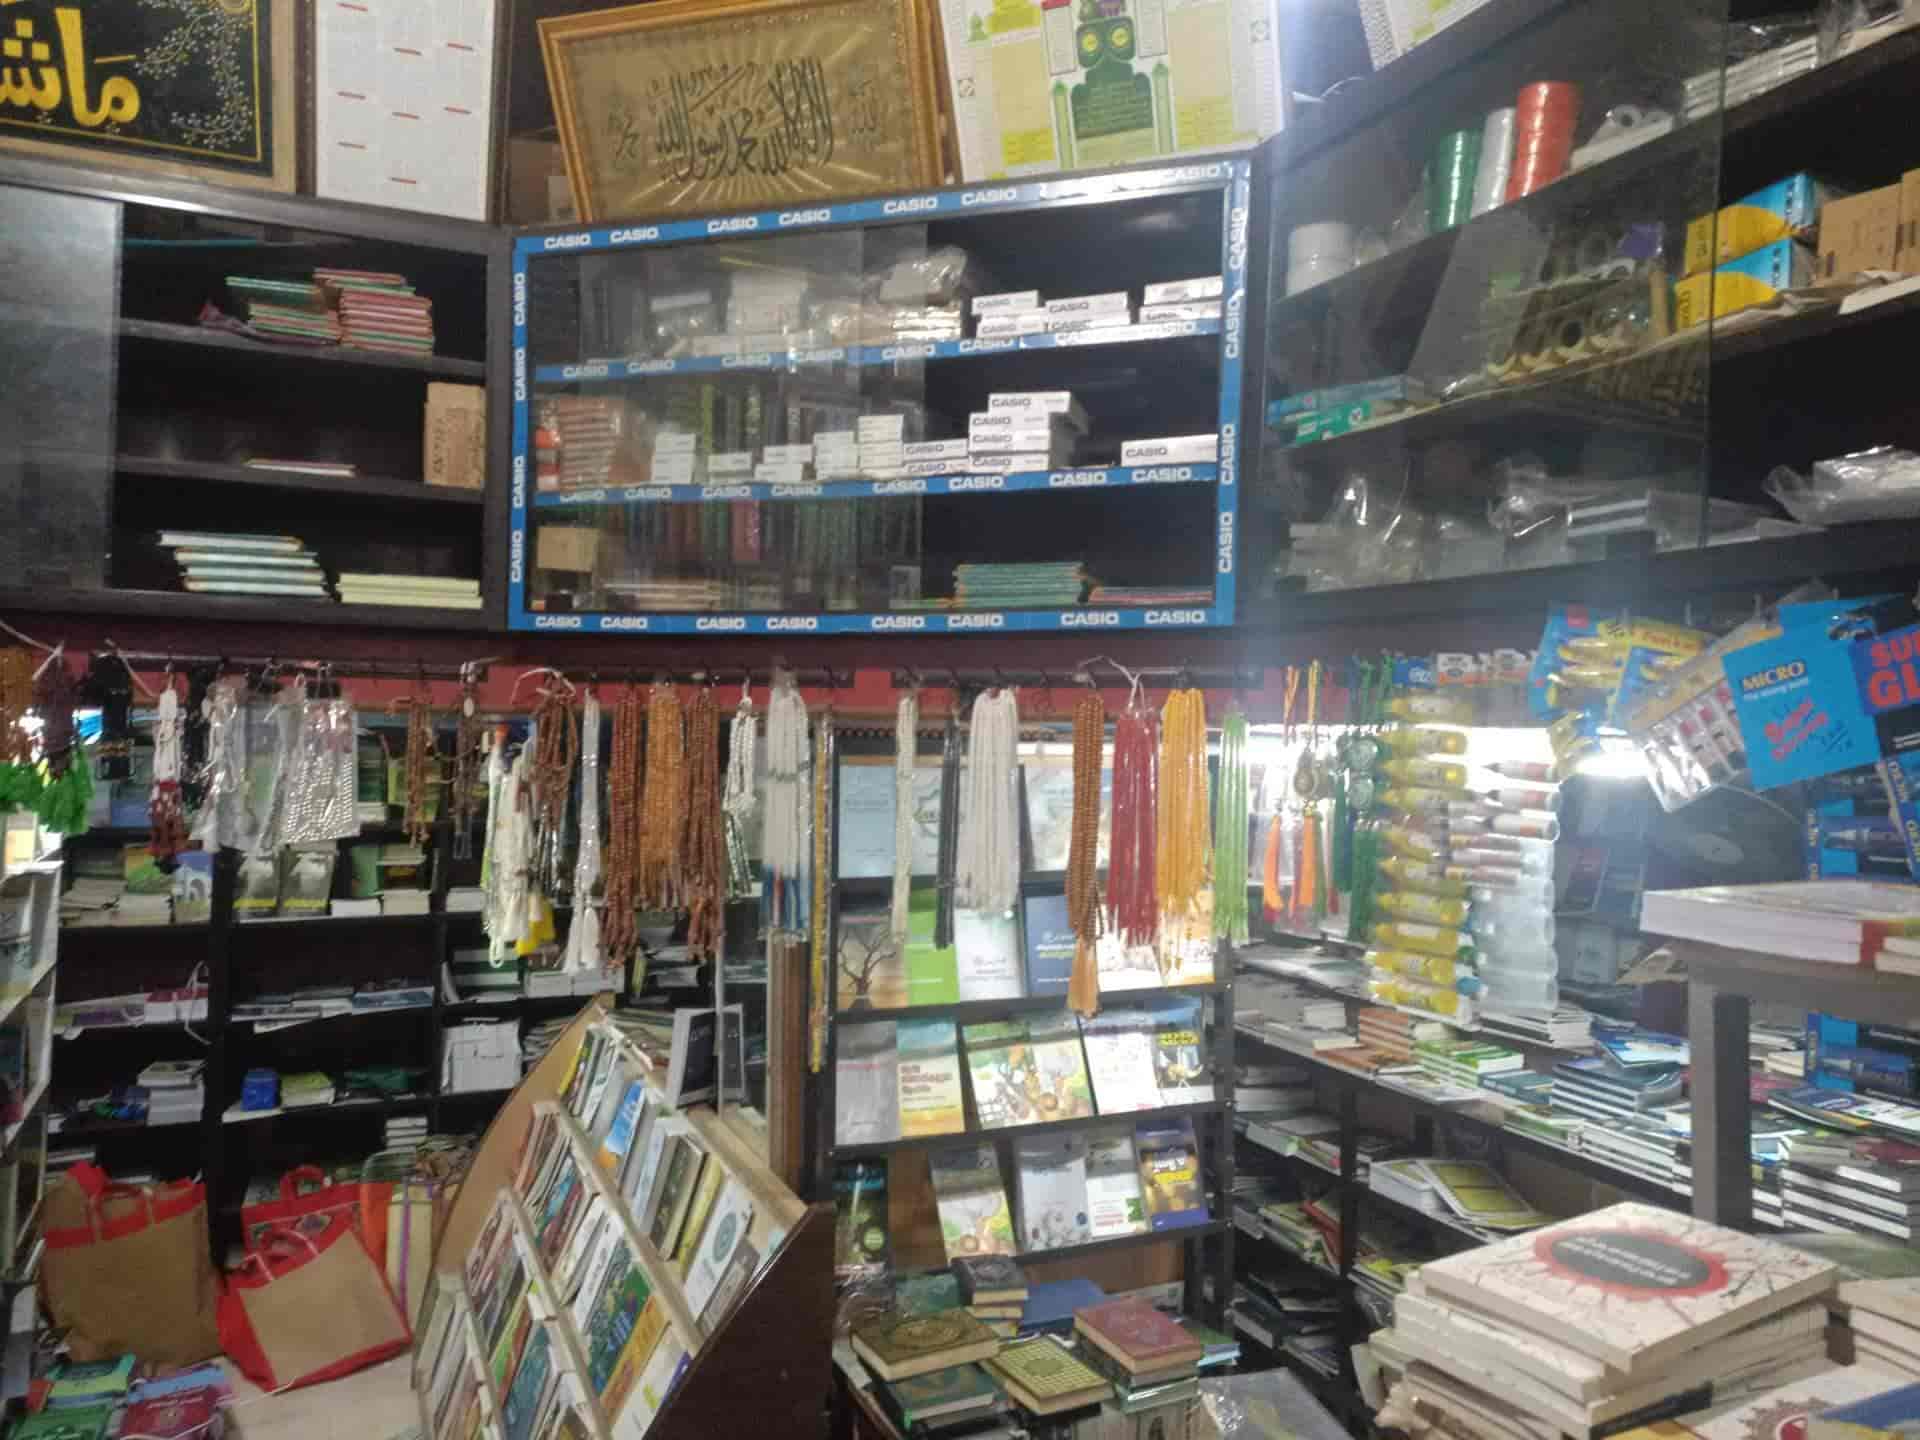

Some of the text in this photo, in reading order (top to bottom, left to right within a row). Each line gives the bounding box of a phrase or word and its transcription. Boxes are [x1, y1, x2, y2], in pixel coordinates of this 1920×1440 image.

[884, 196, 937, 214] CASIO
[961, 188, 1017, 207] CASIO
[707, 215, 758, 234] CASIO
[779, 208, 831, 226] CASIO
[544, 232, 592, 249] CASIO
[610, 226, 659, 243] CASIO
[1229, 207, 1247, 268] CASIO
[513, 272, 526, 326] CASIO
[1050, 301, 1089, 314] CASIO
[1225, 299, 1239, 359] CASIO
[882, 344, 936, 359] CASIO
[959, 337, 1014, 352] CASIO
[563, 364, 608, 379] CASIO
[627, 358, 675, 374] CASIO
[512, 350, 527, 401] CASIO
[991, 397, 1031, 408] CASIO
[972, 416, 1012, 427] CASIO
[972, 432, 1013, 443] CASIO
[906, 443, 945, 455] CASIO
[1125, 446, 1168, 458] CASIO
[1220, 423, 1235, 485] CASIO
[907, 462, 946, 473] CASIO
[972, 456, 1012, 467] CASIO
[513, 456, 524, 509] CASIO
[1049, 470, 1107, 487] CASIO
[1131, 466, 1192, 484] CASIO
[771, 484, 822, 497] CASIO
[872, 479, 927, 494] CASIO
[949, 475, 1005, 491] CASIO
[560, 487, 606, 502] CASIO
[624, 487, 672, 499] CASIO
[702, 484, 751, 498] CASIO
[1218, 511, 1233, 573] CASIO
[512, 531, 523, 583] CASIO
[535, 616, 582, 629] CASIO
[600, 616, 648, 630] CASIO
[696, 616, 746, 630] CASIO
[767, 616, 818, 630] CASIO
[871, 615, 926, 629] CASIO
[947, 613, 1005, 628] CASIO
[1060, 610, 1120, 627] CASIO
[1144, 609, 1207, 625] CASIO
[1743, 661, 1806, 689] MICRO
